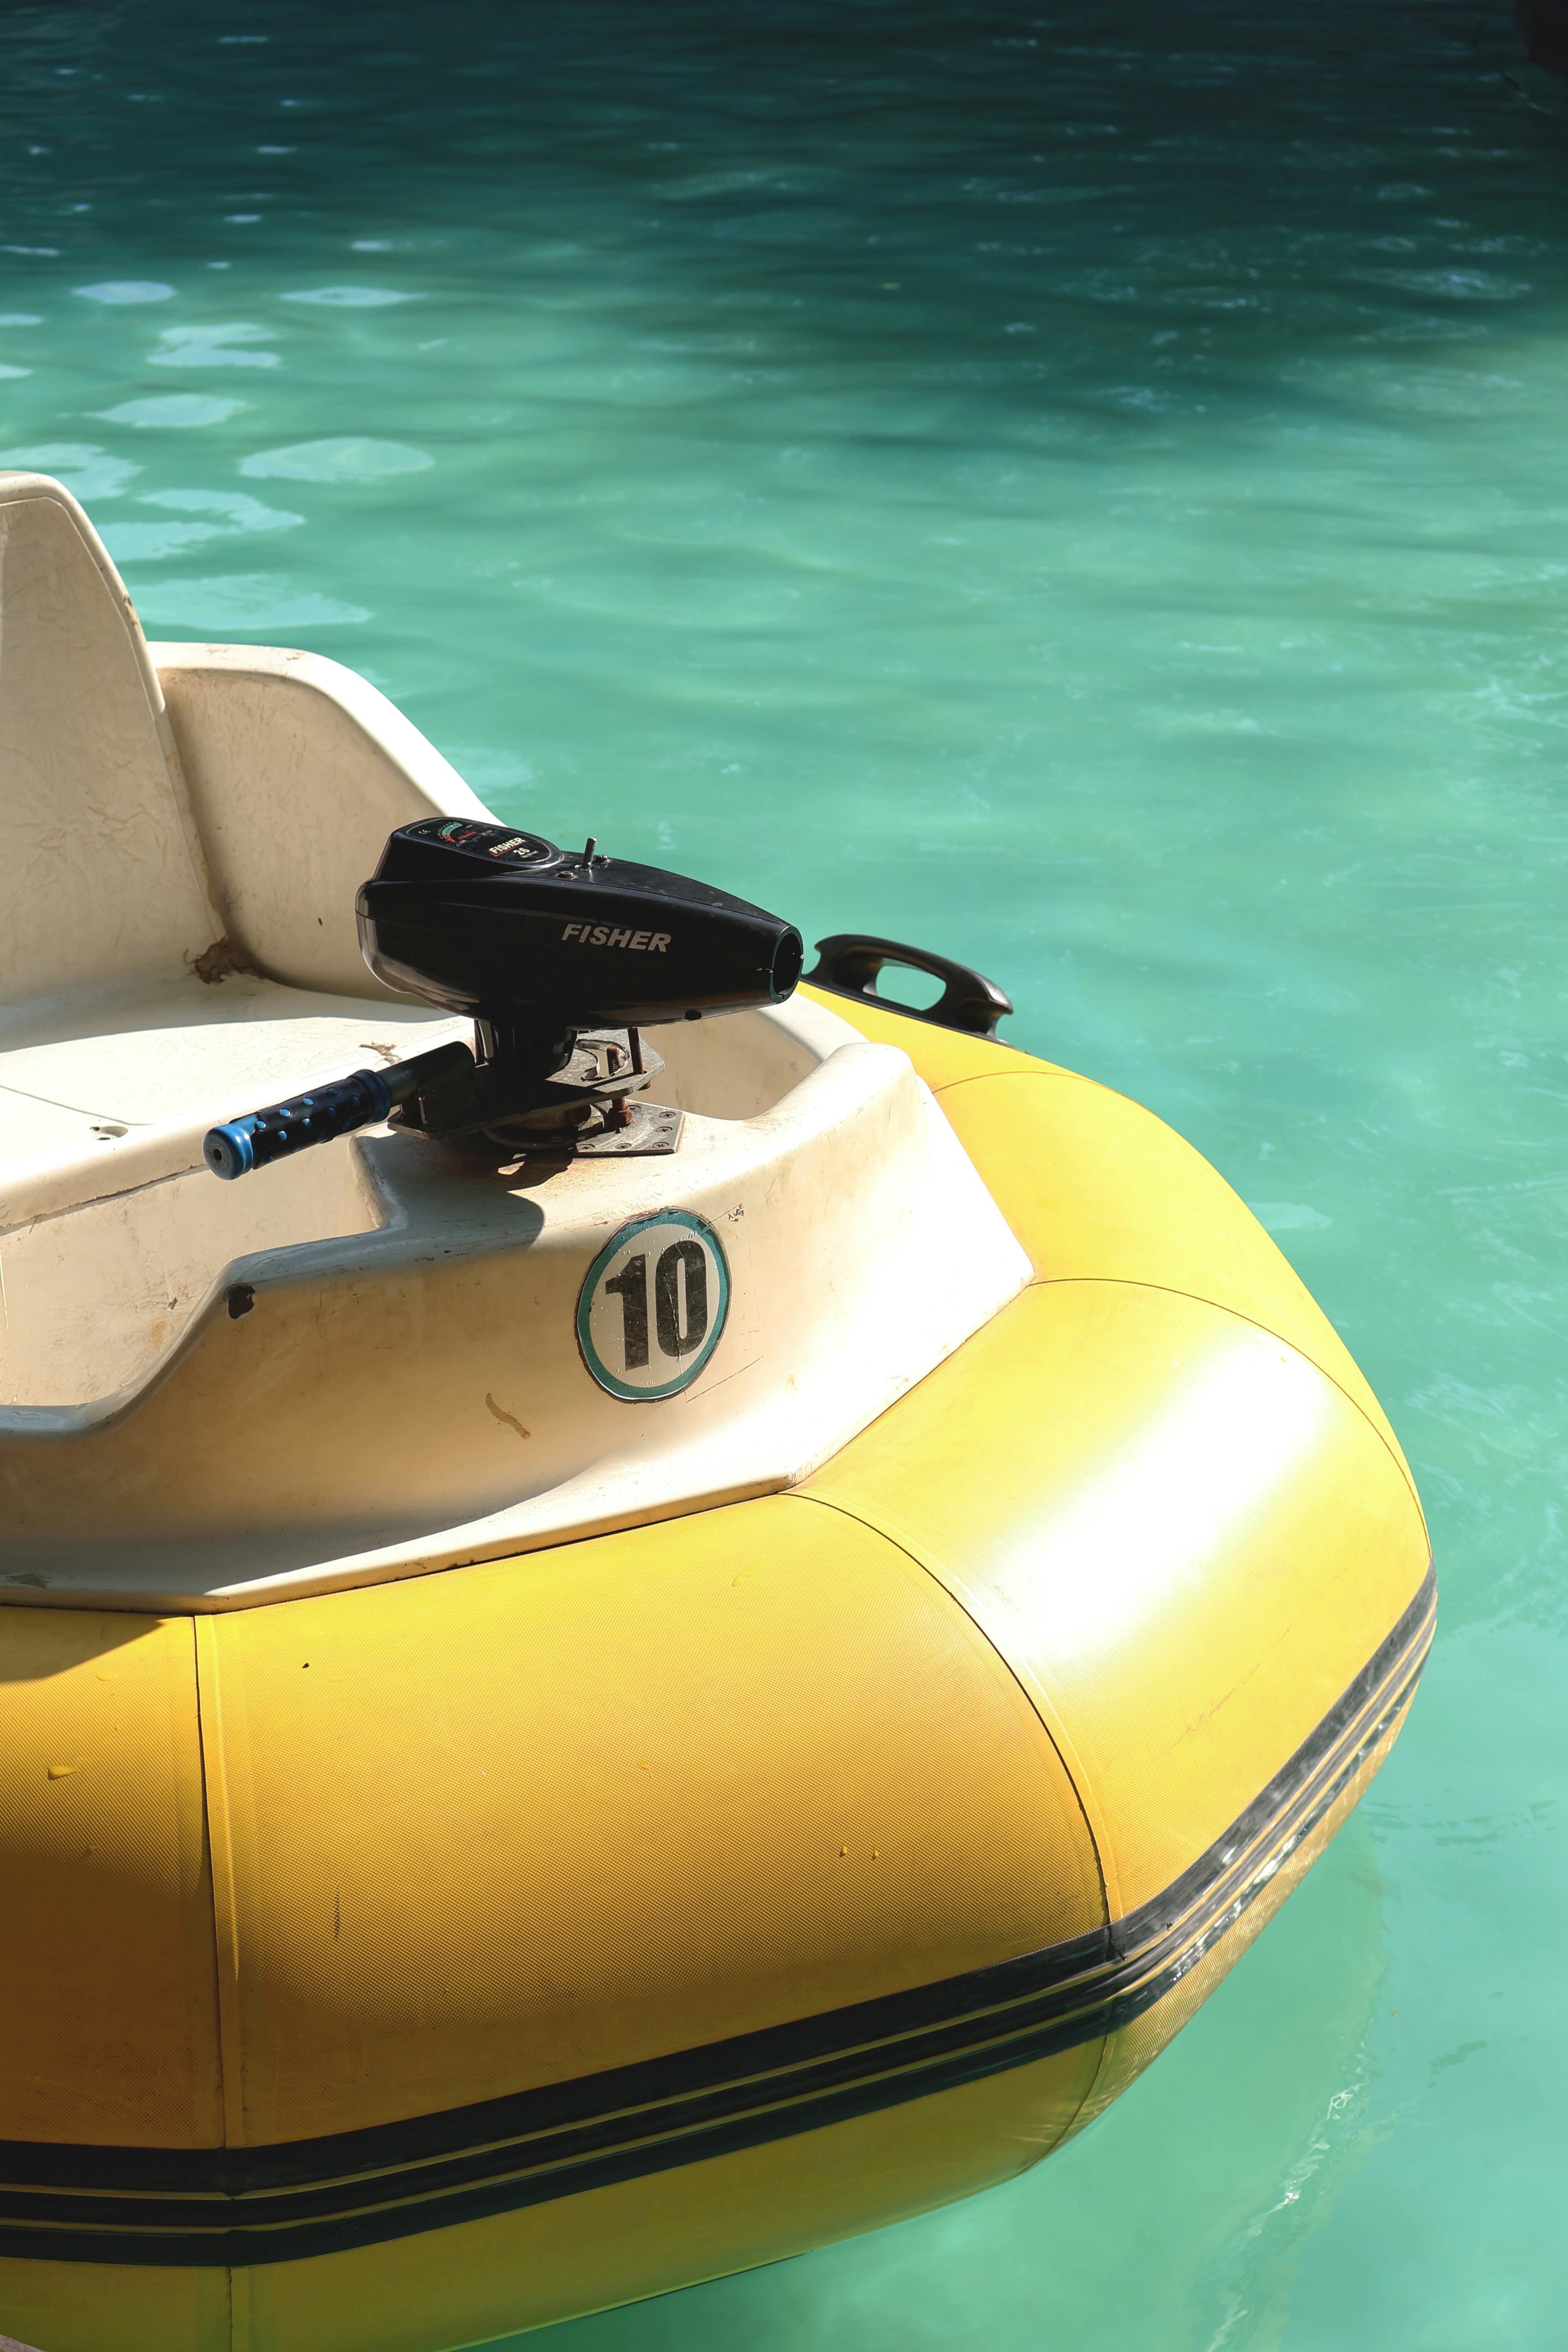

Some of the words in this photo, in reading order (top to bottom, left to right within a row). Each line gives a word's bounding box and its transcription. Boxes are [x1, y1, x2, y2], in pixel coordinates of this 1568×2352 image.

[489, 837, 526, 854] FISHER
[561, 924, 671, 952] FISHER
[605, 1240, 708, 1371] 10
